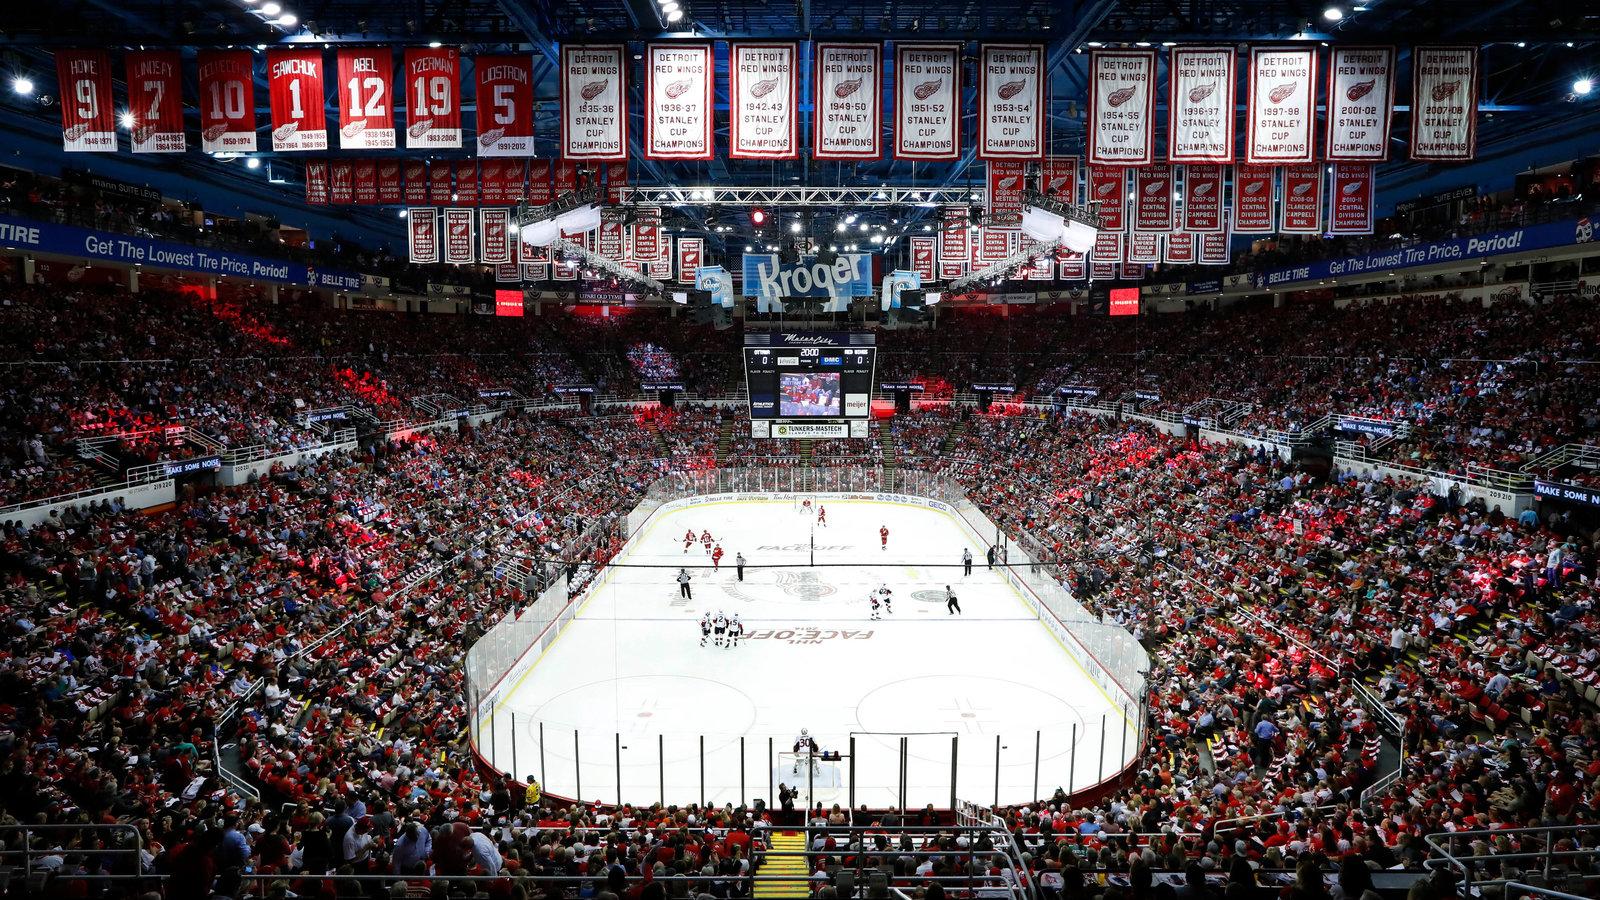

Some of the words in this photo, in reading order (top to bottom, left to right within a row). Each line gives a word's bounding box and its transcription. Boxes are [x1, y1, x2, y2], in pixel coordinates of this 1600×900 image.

[575, 55, 613, 64] DETROIT
[659, 54, 699, 62] DETROIT
[745, 53, 784, 62] DETROIT
[829, 54, 868, 62] DETROIT
[909, 54, 948, 63] DETROIT
[993, 54, 1031, 63] DETROIT
[1183, 57, 1222, 66] DETROIT
[1263, 57, 1302, 66] DETROIT
[1343, 54, 1383, 64] DETROIT
[1426, 54, 1465, 64] DETROIT
[70, 59, 97, 75] HOWE
[272, 59, 318, 79] SAWCHUK
[353, 58, 379, 73] ABEL
[411, 57, 454, 76] YZERMAN
[655, 66, 672, 74] RED
[677, 66, 703, 74] WINGS
[741, 65, 757, 73] RED
[762, 65, 788, 73] WINGS
[825, 65, 842, 73] RED
[847, 65, 873, 73] WINGS
[905, 65, 922, 74] RED
[926, 65, 952, 74] WINGS
[988, 65, 1006, 74] RED
[1010, 65, 1036, 74] WINGS
[1103, 61, 1143, 70] DETROIT
[571, 67, 588, 75] RED
[593, 67, 619, 75] WINGS
[1179, 69, 1197, 78] RED
[1201, 69, 1226, 78] WINGS
[1259, 68, 1277, 78] RED
[1281, 68, 1307, 78] WINGS
[1338, 66, 1356, 75] RED
[1360, 66, 1386, 75] WINGS
[1421, 66, 1440, 75] RED
[1443, 66, 1470, 75] WINGS
[481, 65, 528, 87] LIDSTROM
[1099, 72, 1117, 81] RED
[1120, 73, 1147, 82] WINGS
[76, 80, 99, 119] 9
[144, 81, 165, 119] 7
[209, 80, 244, 119] 10
[289, 79, 304, 118] 1
[347, 77, 386, 117] 12
[414, 77, 452, 116] 19
[493, 85, 516, 125] 5
[579, 105, 614, 113] 1935-36
[660, 104, 697, 112] 1936-37
[830, 103, 867, 111] 1949-50
[911, 104, 945, 112] 1951-52
[993, 104, 1030, 113] 1953-54
[1341, 105, 1377, 114] 2001-02
[1425, 105, 1463, 114] 2007-08
[1103, 111, 1140, 120] 1954-55
[1184, 107, 1220, 116] 1996-97
[1263, 107, 1300, 116] 1997-98
[576, 117, 614, 126] STANLEY
[659, 117, 698, 125] STANLEY
[744, 115, 785, 124] STANLEY
[828, 115, 868, 123] STANLEY
[907, 117, 947, 125] STANLEY
[991, 116, 1031, 124] STANLEY
[1182, 119, 1220, 128] STANLEY
[1261, 119, 1300, 128] STANLEY
[1339, 118, 1378, 127] STANLEY
[1424, 118, 1463, 127] STANLEY
[839, 127, 856, 135] CUP
[1101, 123, 1140, 131] STANLEY
[670, 129, 688, 137] CUP
[918, 129, 936, 137] CUP
[1002, 128, 1020, 136] CUP
[1192, 131, 1210, 140] CUP
[1271, 132, 1290, 140] CUP
[1349, 131, 1367, 140] CUP
[1433, 131, 1451, 139] CUP
[426, 133, 457, 142] 1983-2006
[1111, 135, 1130, 144] CUP
[496, 142, 527, 151] 1991-2012
[571, 141, 619, 150] CHAMPIONS
[655, 140, 703, 149] CHAMPIONS
[740, 139, 788, 148] CHAMPIONS
[823, 139, 872, 148] CHAMPIONS
[903, 140, 952, 149] CHAMPIONS
[987, 140, 1036, 148] CHAMPIONS
[1177, 143, 1224, 152] CHAMPIONS
[1255, 143, 1305, 152] CHAMPIONS
[1333, 142, 1382, 152] CHAMPIONS
[1418, 142, 1467, 151] CHAMPIONS
[1096, 146, 1144, 156] CHAMPIONS
[0, 223, 40, 245] TIRE
[85, 235, 113, 257] Get
[118, 241, 144, 260] The
[149, 245, 194, 267] Lowest
[197, 253, 218, 271] Tire
[221, 256, 250, 275] Price,
[253, 262, 288, 278] Period!
[1330, 261, 1346, 274] Get
[1348, 259, 1363, 271] The
[1366, 254, 1402, 269] Lowest
[1405, 250, 1425, 263] Tire
[1428, 243, 1462, 260] Price,
[1467, 231, 1523, 254] Period!
[1269, 271, 1291, 284] BELLE
[1292, 268, 1310, 279] TIRE
[321, 274, 343, 286] BELLE
[345, 277, 360, 288] TIRE
[757, 254, 861, 312] Kroger
[781, 334, 813, 343] Motor
[813, 336, 838, 346] City
[800, 348, 819, 357] 20:00
[762, 356, 768, 364] 0
[857, 356, 863, 364] 0
[846, 402, 867, 410] meijer
[1342, 421, 1356, 429] MAKE
[1358, 423, 1371, 431] SOME
[1373, 427, 1390, 435] NOISE
[185, 462, 200, 471] SOME
[202, 459, 220, 468] NOISE
[1500, 492, 1512, 500] 210
[1536, 483, 1560, 497] MAKE
[1564, 487, 1587, 501] SOME
[928, 500, 946, 511] GEICO
[718, 615, 724, 623] 2
[737, 630, 874, 640] FACE-OFF
[799, 738, 810, 748] 30
